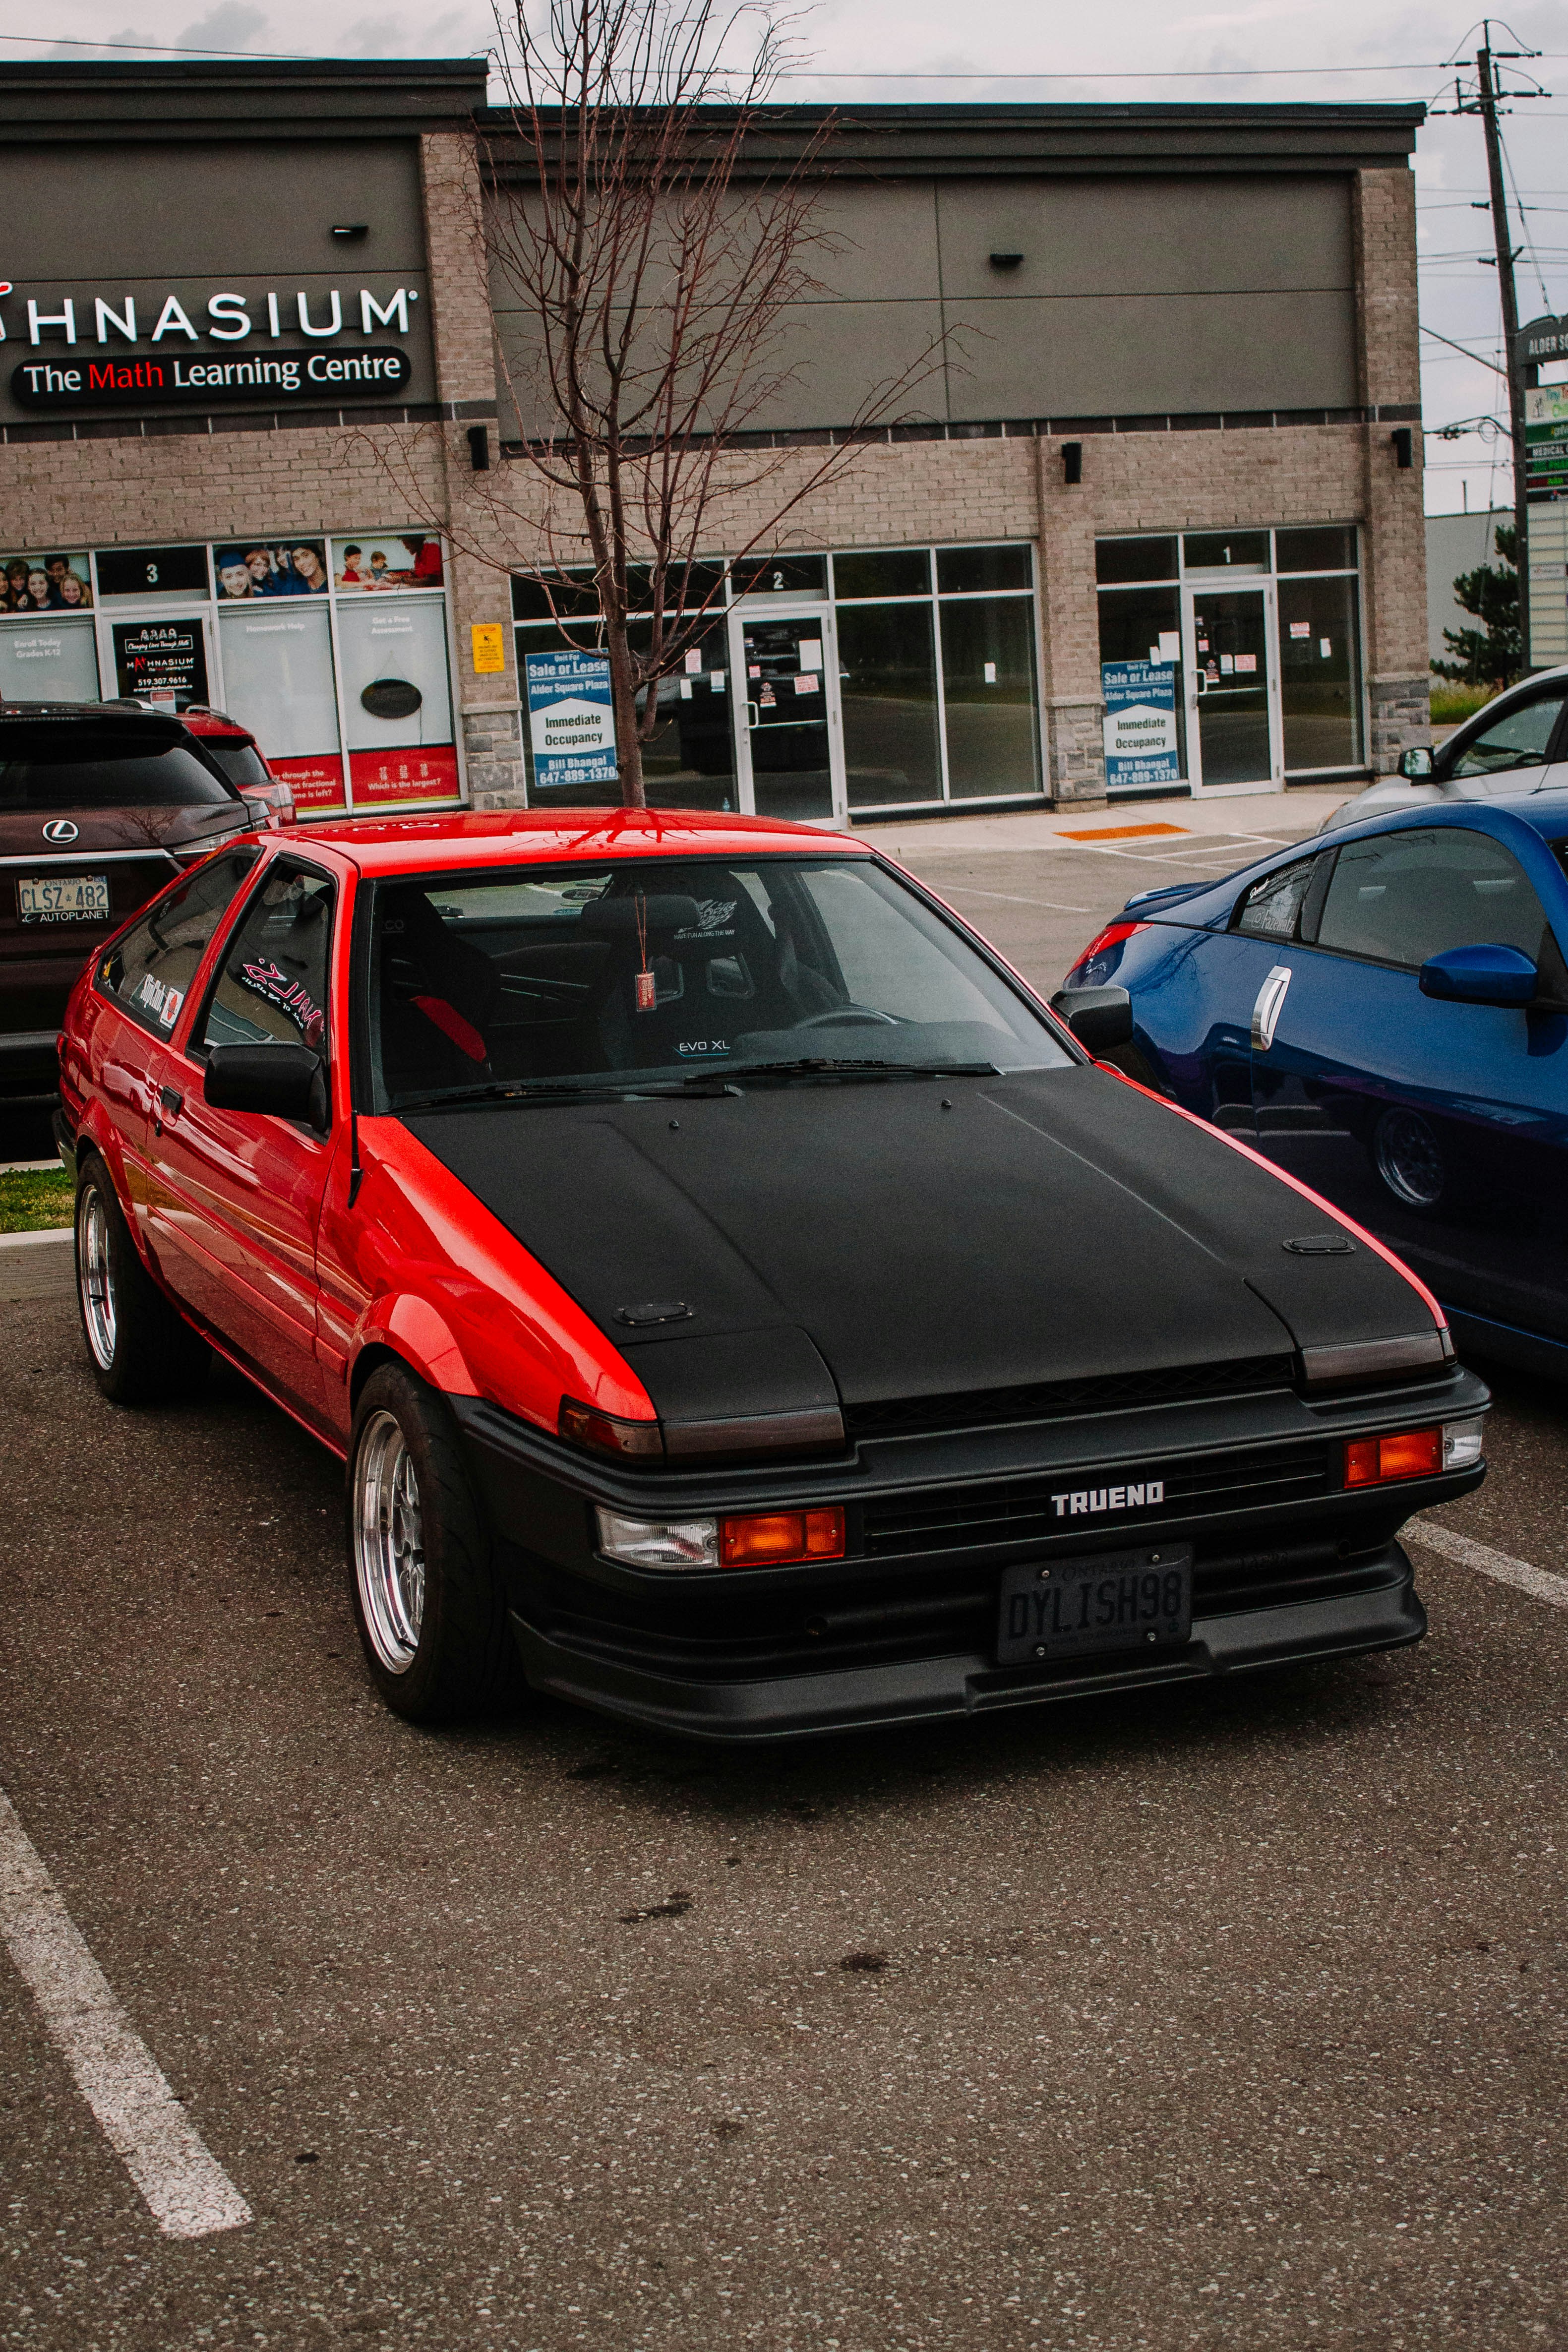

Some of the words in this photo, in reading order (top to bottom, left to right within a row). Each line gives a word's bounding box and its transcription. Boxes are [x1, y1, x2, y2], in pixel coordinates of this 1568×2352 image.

[0, 282, 410, 346] HNASIUM
[1529, 336, 1557, 356] ALDER
[23, 365, 81, 393] The
[89, 362, 164, 390] Math
[174, 357, 301, 391] Learning
[307, 354, 401, 382] Centre
[1223, 546, 1231, 564] 1
[147, 564, 158, 583] 3
[773, 571, 784, 589] 2
[38, 638, 61, 648] Today
[529, 663, 556, 676] Sale
[558, 664, 570, 675] or
[573, 661, 607, 673] Lease
[138, 676, 187, 686] 519.307.9616
[1105, 671, 1127, 685] Sale
[1130, 673, 1141, 682] or
[1143, 670, 1173, 681] Lease
[531, 684, 553, 694] Alder
[554, 682, 584, 694] Square
[585, 680, 608, 690] Plaza
[1126, 690, 1151, 701] Square
[545, 714, 601, 728] Immediate
[1118, 718, 1166, 730] Immediate
[545, 732, 603, 746] Occupancy
[1116, 737, 1166, 749] Occupancy
[548, 759, 566, 770] Bill
[567, 755, 606, 768] Bhangal
[1118, 761, 1133, 772] Bill
[1135, 758, 1169, 770] Bhangal
[282, 770, 310, 780] through
[540, 766, 615, 784] 647-889-1370
[1110, 768, 1177, 784] 647-889-1370
[302, 779, 336, 788] fractional
[368, 782, 390, 790] Which
[412, 778, 441, 787] largest?
[315, 789, 332, 797] left?
[45, 878, 81, 887] ONTARIO
[21, 887, 64, 911] CLSZ
[76, 885, 107, 908] 482
[40, 910, 110, 922] AUTOPLANET
[679, 1042, 707, 1051] EVO
[712, 1040, 730, 1050] XL
[1051, 1482, 1164, 1516] TRUENO
[1009, 1570, 1182, 1638] DYLISH98
